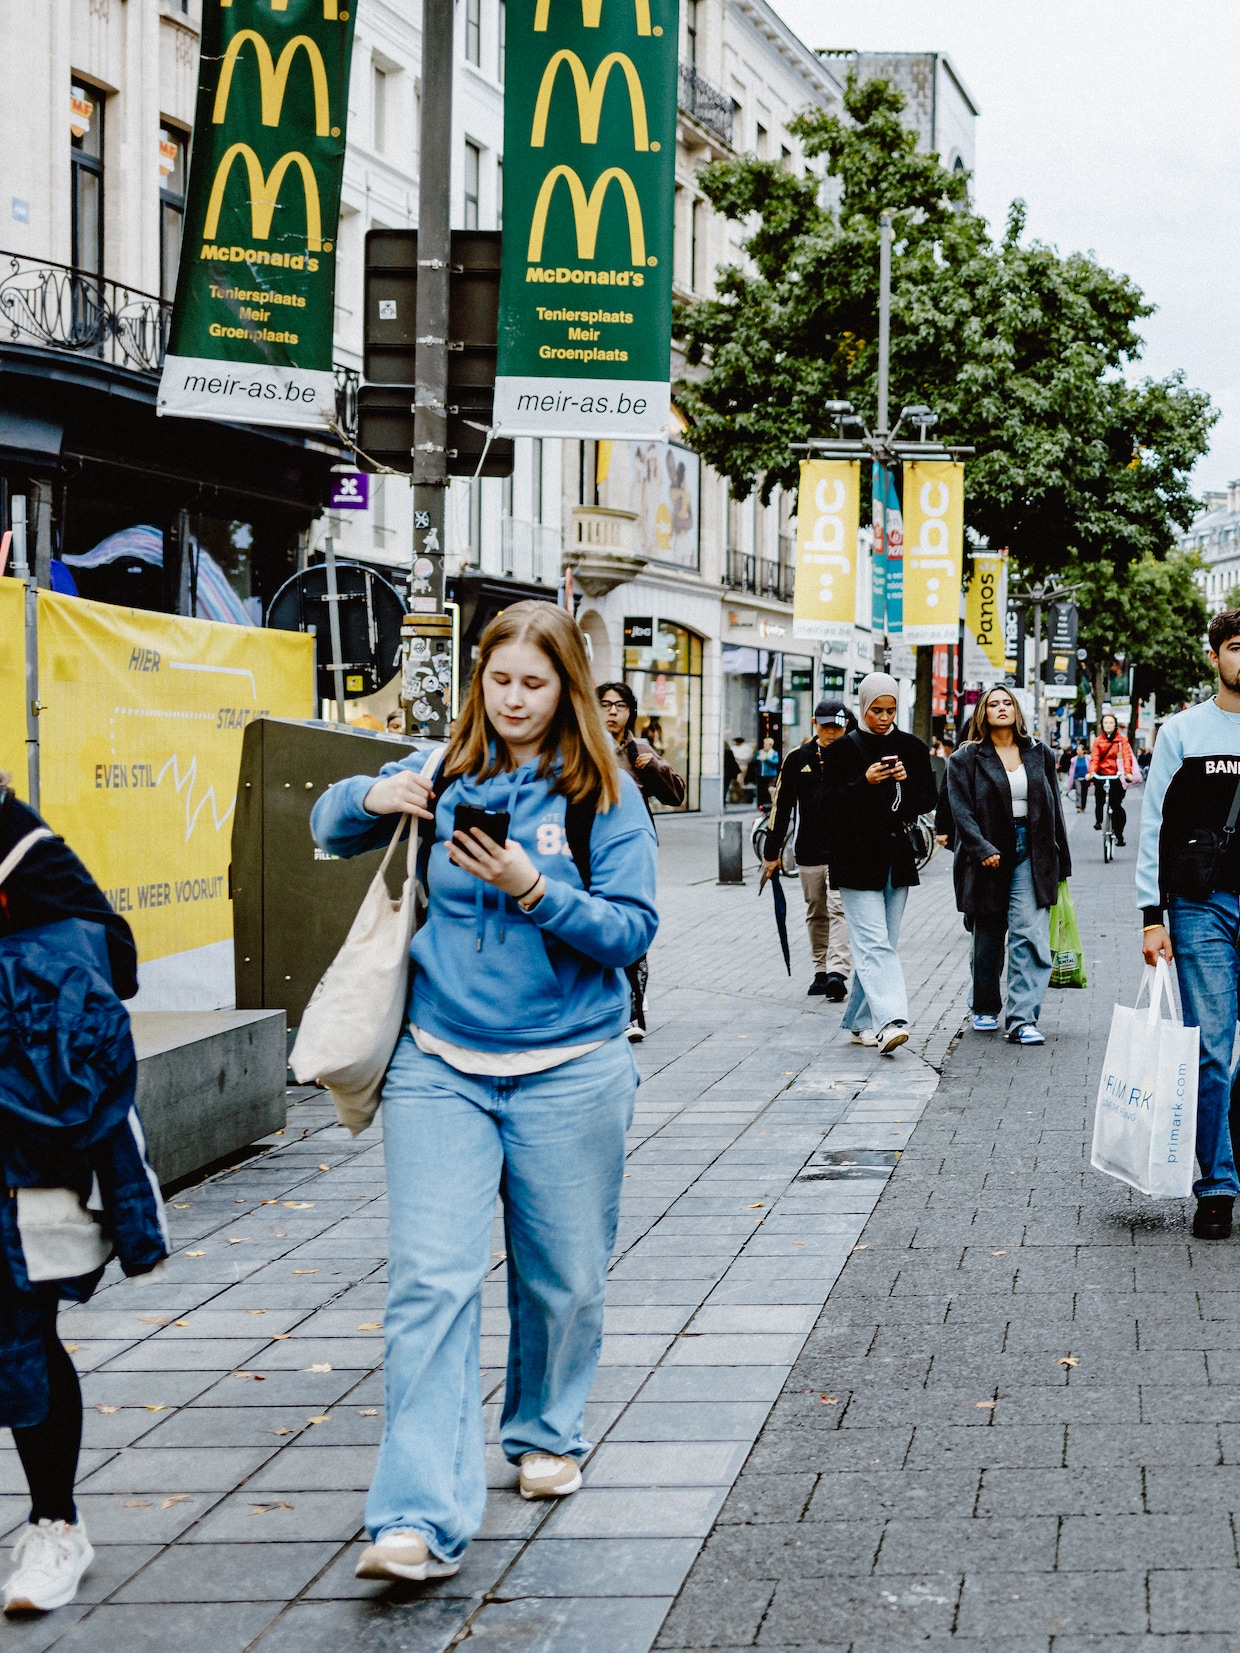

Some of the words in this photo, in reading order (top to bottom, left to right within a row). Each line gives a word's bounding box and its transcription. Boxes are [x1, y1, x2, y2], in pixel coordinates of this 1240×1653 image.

[200, 244, 319, 272] McDonald's
[525, 267, 645, 287] McDonald's
[209, 285, 306, 308] Teniersplaats
[239, 306, 271, 322] Meir
[536, 307, 634, 324] Teniersplaats
[209, 323, 299, 345] Groenplaats
[568, 327, 601, 341] Meir
[539, 345, 629, 363] Groenplaats
[184, 374, 316, 403] meir-as.be
[517, 391, 647, 415] meir-as.be
[802, 478, 851, 575] jbc
[910, 481, 955, 577] jbc
[976, 573, 994, 645] Panos
[128, 647, 161, 672] HIER
[216, 708, 250, 729] STAAT
[95, 764, 128, 788] EVEN
[131, 764, 156, 788] STIL
[103, 887, 133, 912] NEL
[137, 883, 171, 908] WEER
[174, 876, 223, 903] VOORUIT
[1167, 1063, 1187, 1163] primark.com
